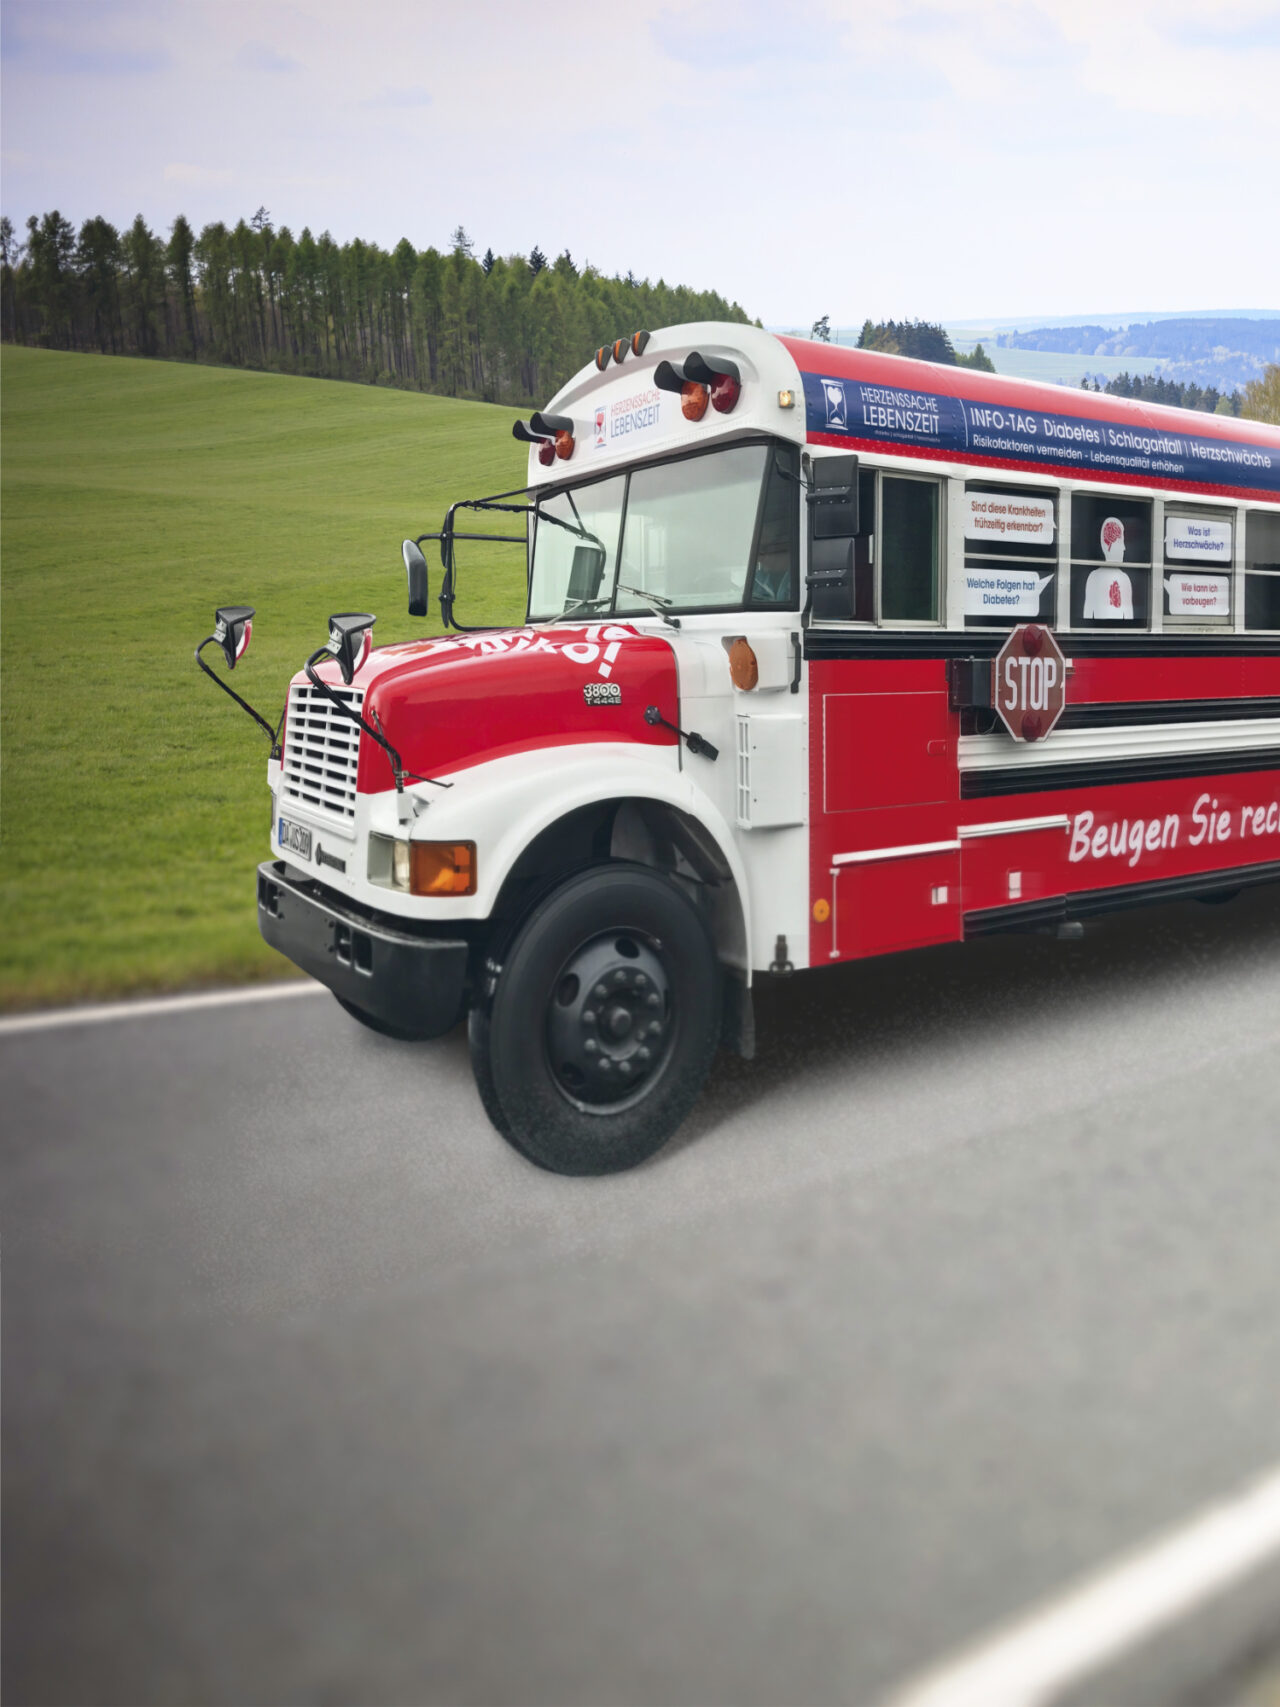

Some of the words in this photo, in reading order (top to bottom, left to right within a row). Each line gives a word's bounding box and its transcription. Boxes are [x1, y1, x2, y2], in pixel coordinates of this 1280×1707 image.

[859, 386, 940, 413] HERZENSSACHE
[611, 403, 660, 438] LEBENSZEIT
[863, 405, 940, 435] LEBENSZEIT
[970, 407, 1037, 434] INFO-TAG
[1043, 419, 1100, 443] Diabetes
[1108, 429, 1183, 456] Schlaganfall
[1190, 441, 1272, 469] Herzschwäche
[973, 434, 1035, 454] Risikofaktoren
[1037, 445, 1083, 460] vermeiden
[1090, 450, 1151, 469] Lebensqualität
[1152, 459, 1185, 474] erhöhen
[971, 501, 987, 513] Sind
[988, 503, 1007, 514] diese
[1007, 504, 1046, 518] Krankheiten
[974, 517, 1006, 533] frühzeitig
[1006, 521, 1043, 533] erkennbar?
[1187, 526, 1201, 536] Was
[1203, 527, 1211, 537] ist
[1173, 538, 1224, 551] Herzschwäche?
[967, 578, 995, 590] Welche
[996, 579, 1022, 592] Folgen
[1022, 580, 1036, 591] hat
[1193, 583, 1208, 593] kann
[1209, 584, 1218, 593] ich
[983, 593, 1020, 605] Diabetes?
[1182, 596, 1217, 608] vorbeugen?
[584, 683, 621, 697] 3800
[1004, 656, 1057, 711] STOP
[1068, 810, 1180, 868] Beugen
[1188, 792, 1232, 846] Sie
